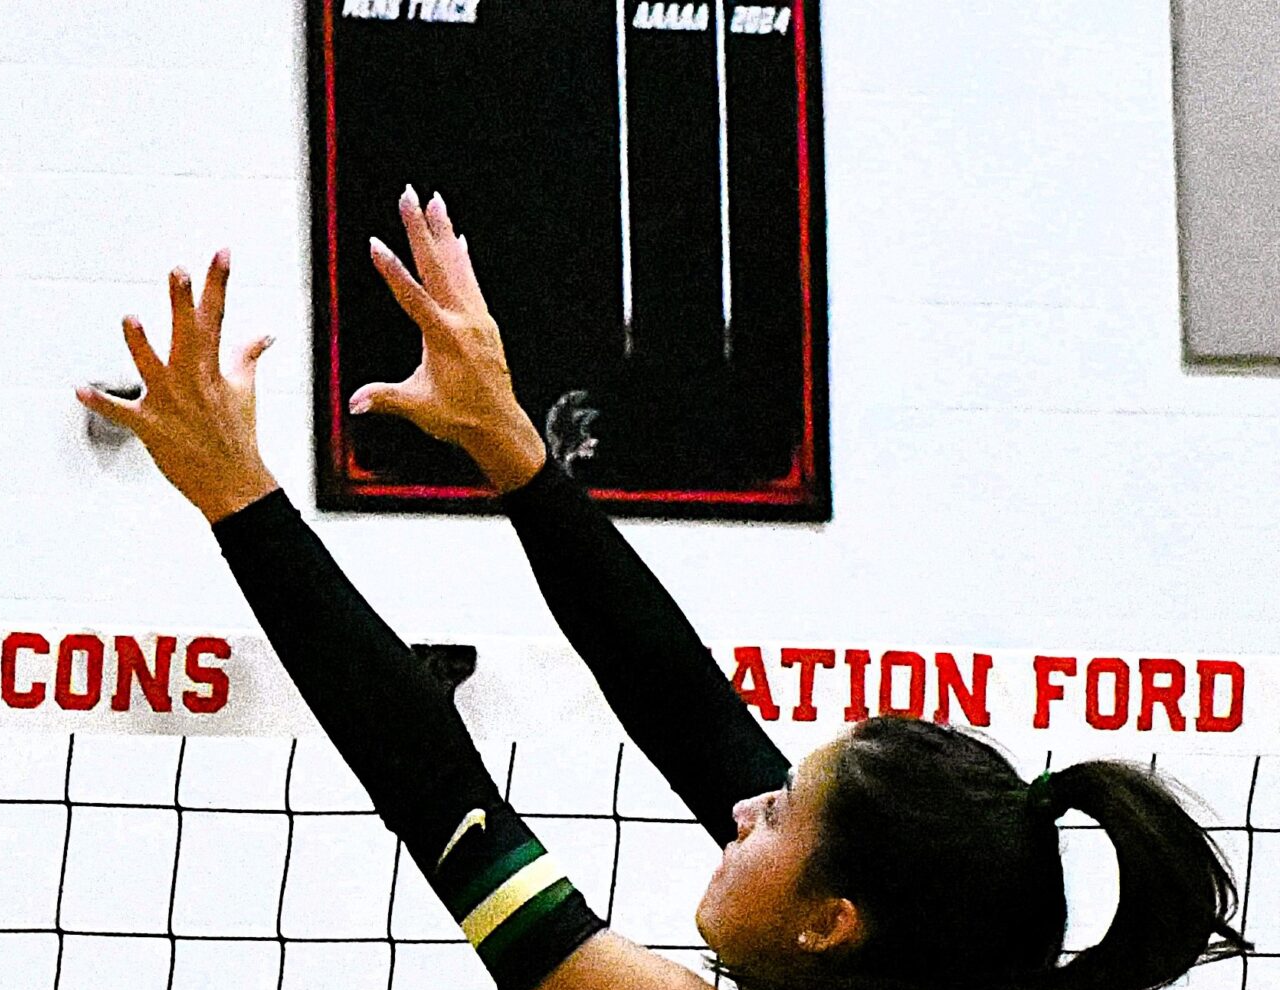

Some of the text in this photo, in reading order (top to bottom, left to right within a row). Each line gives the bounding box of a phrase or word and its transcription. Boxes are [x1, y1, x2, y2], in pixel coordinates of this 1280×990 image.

[632, 1, 710, 31] AAAAA
[730, 5, 792, 36] 2024
[724, 645, 1245, 733] ATION FORD
